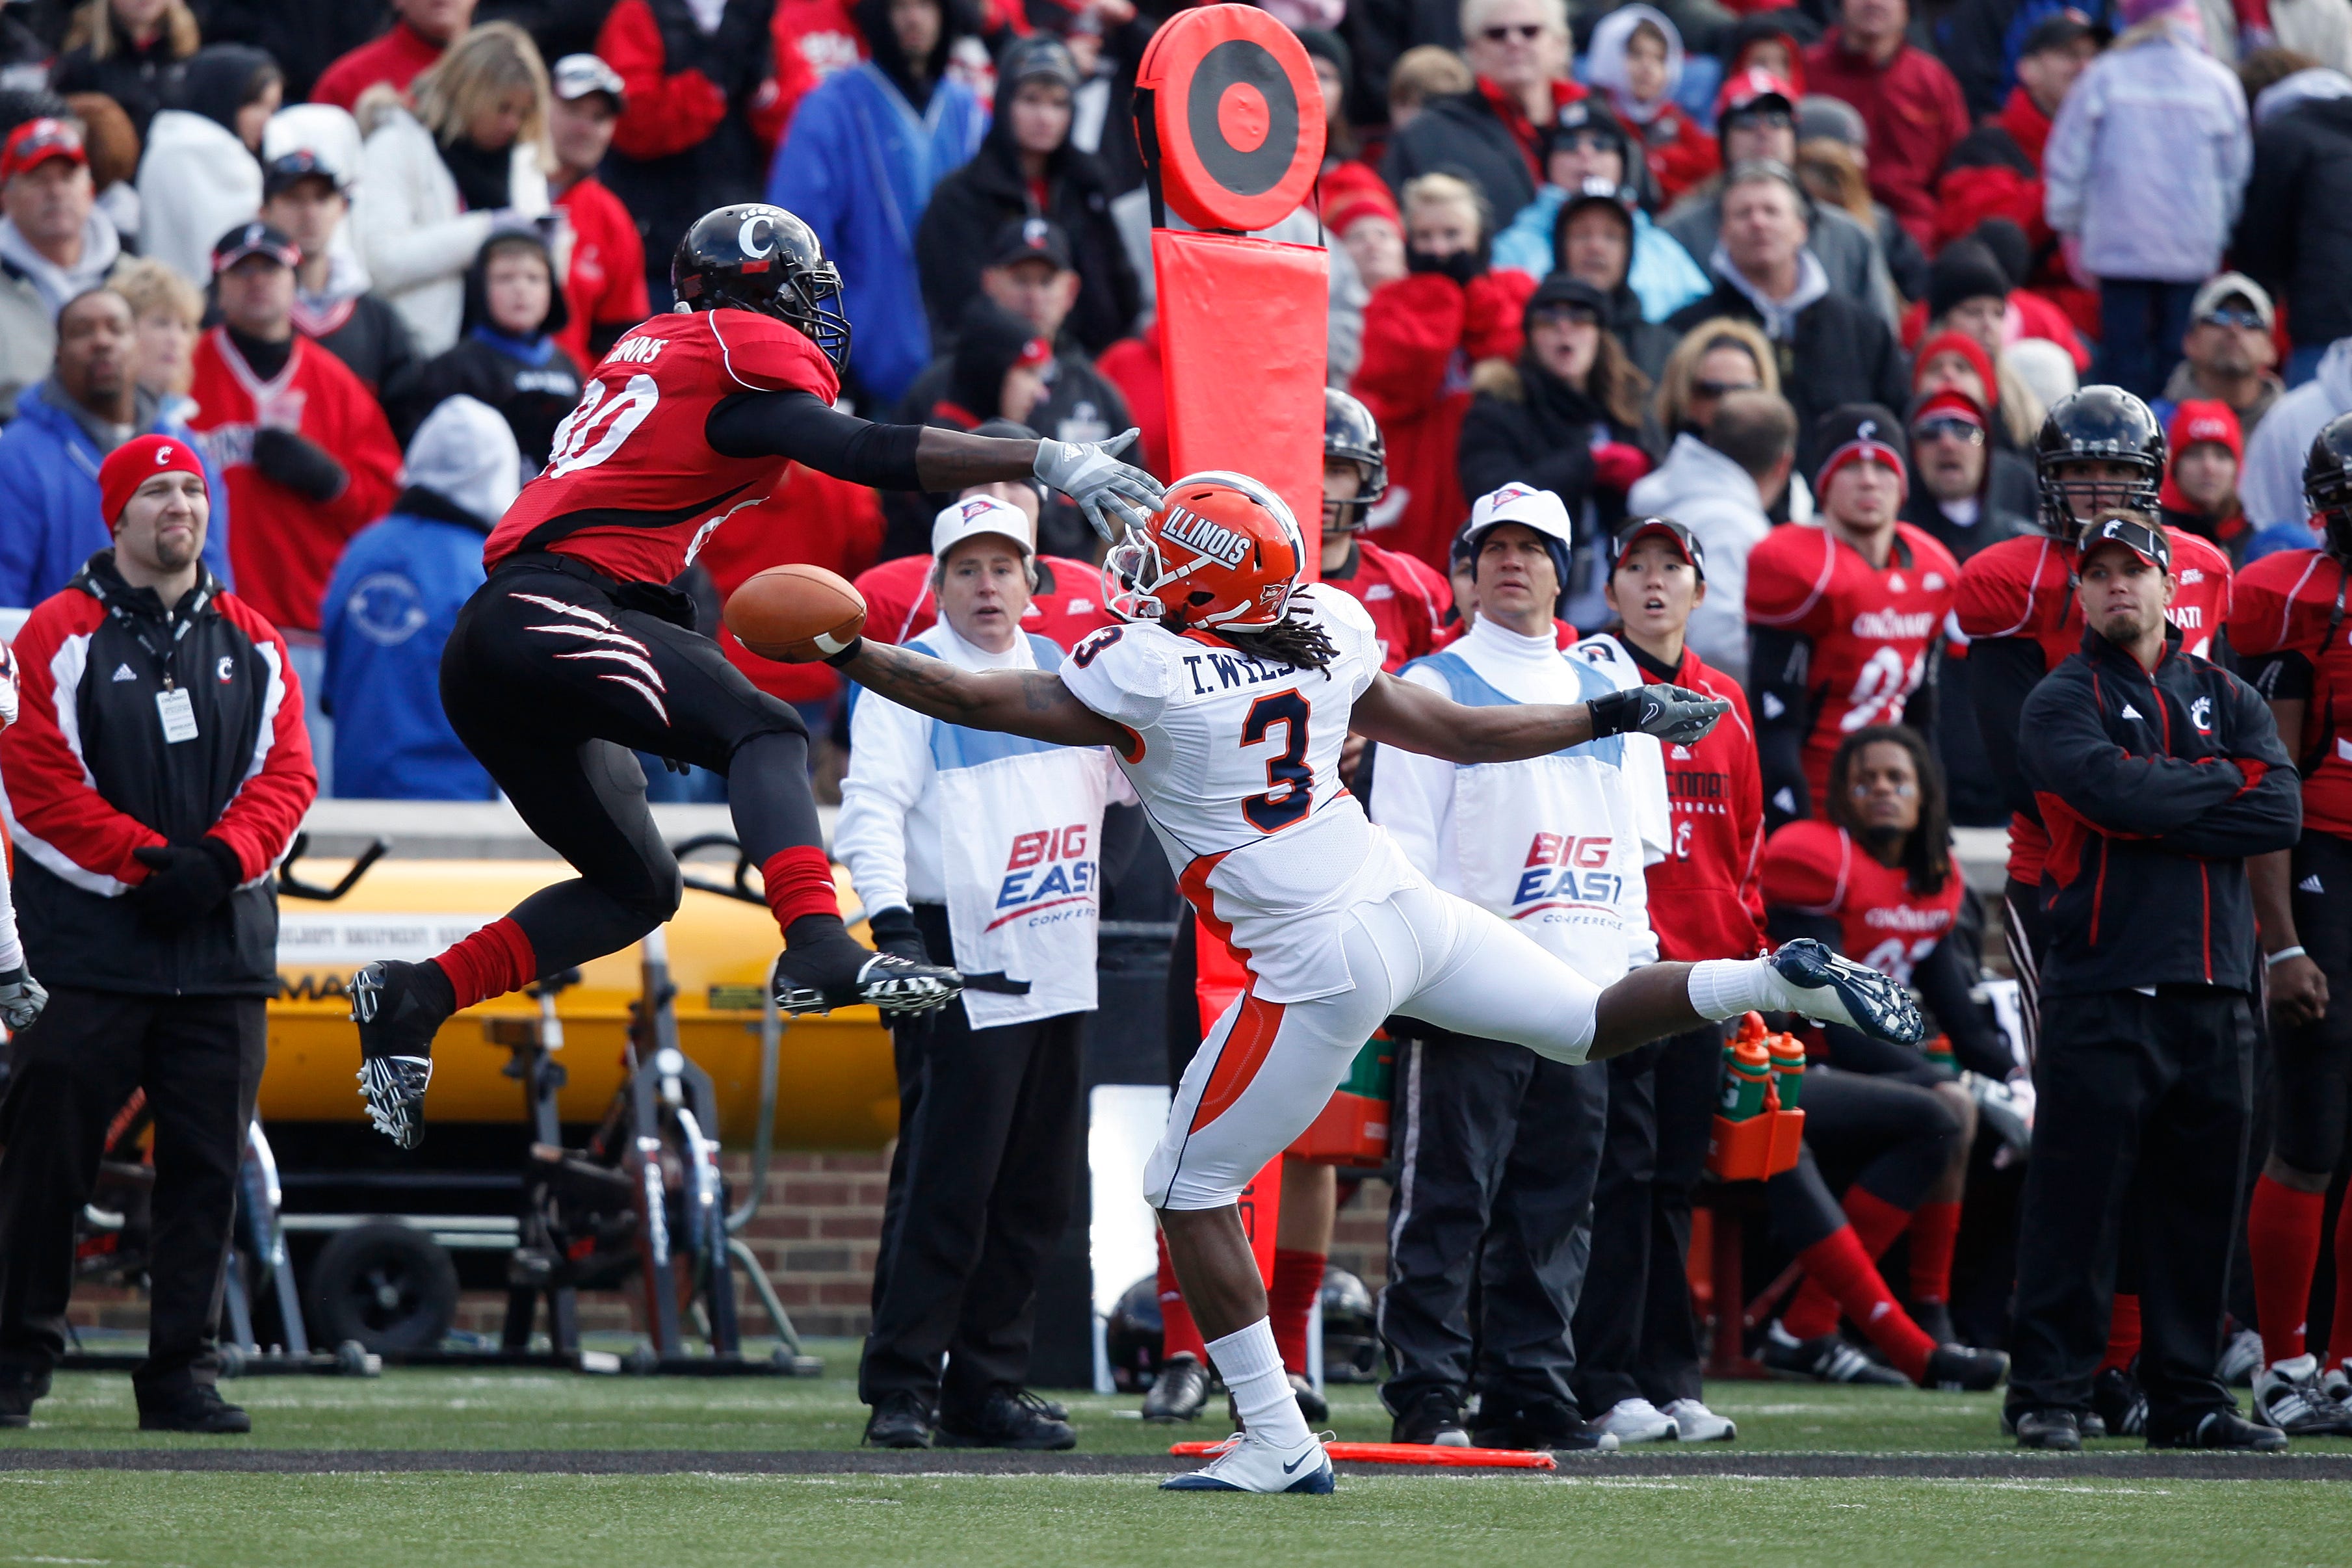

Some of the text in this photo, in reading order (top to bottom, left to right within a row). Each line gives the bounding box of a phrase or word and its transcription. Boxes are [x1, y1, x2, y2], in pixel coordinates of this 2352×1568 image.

[738, 207, 779, 258] C
[1161, 504, 1252, 564] ILLINOIS
[1073, 626, 1124, 670] 3
[1239, 687, 1315, 835] 3
[1006, 823, 1088, 872] BIG
[1524, 831, 1614, 869] BIG
